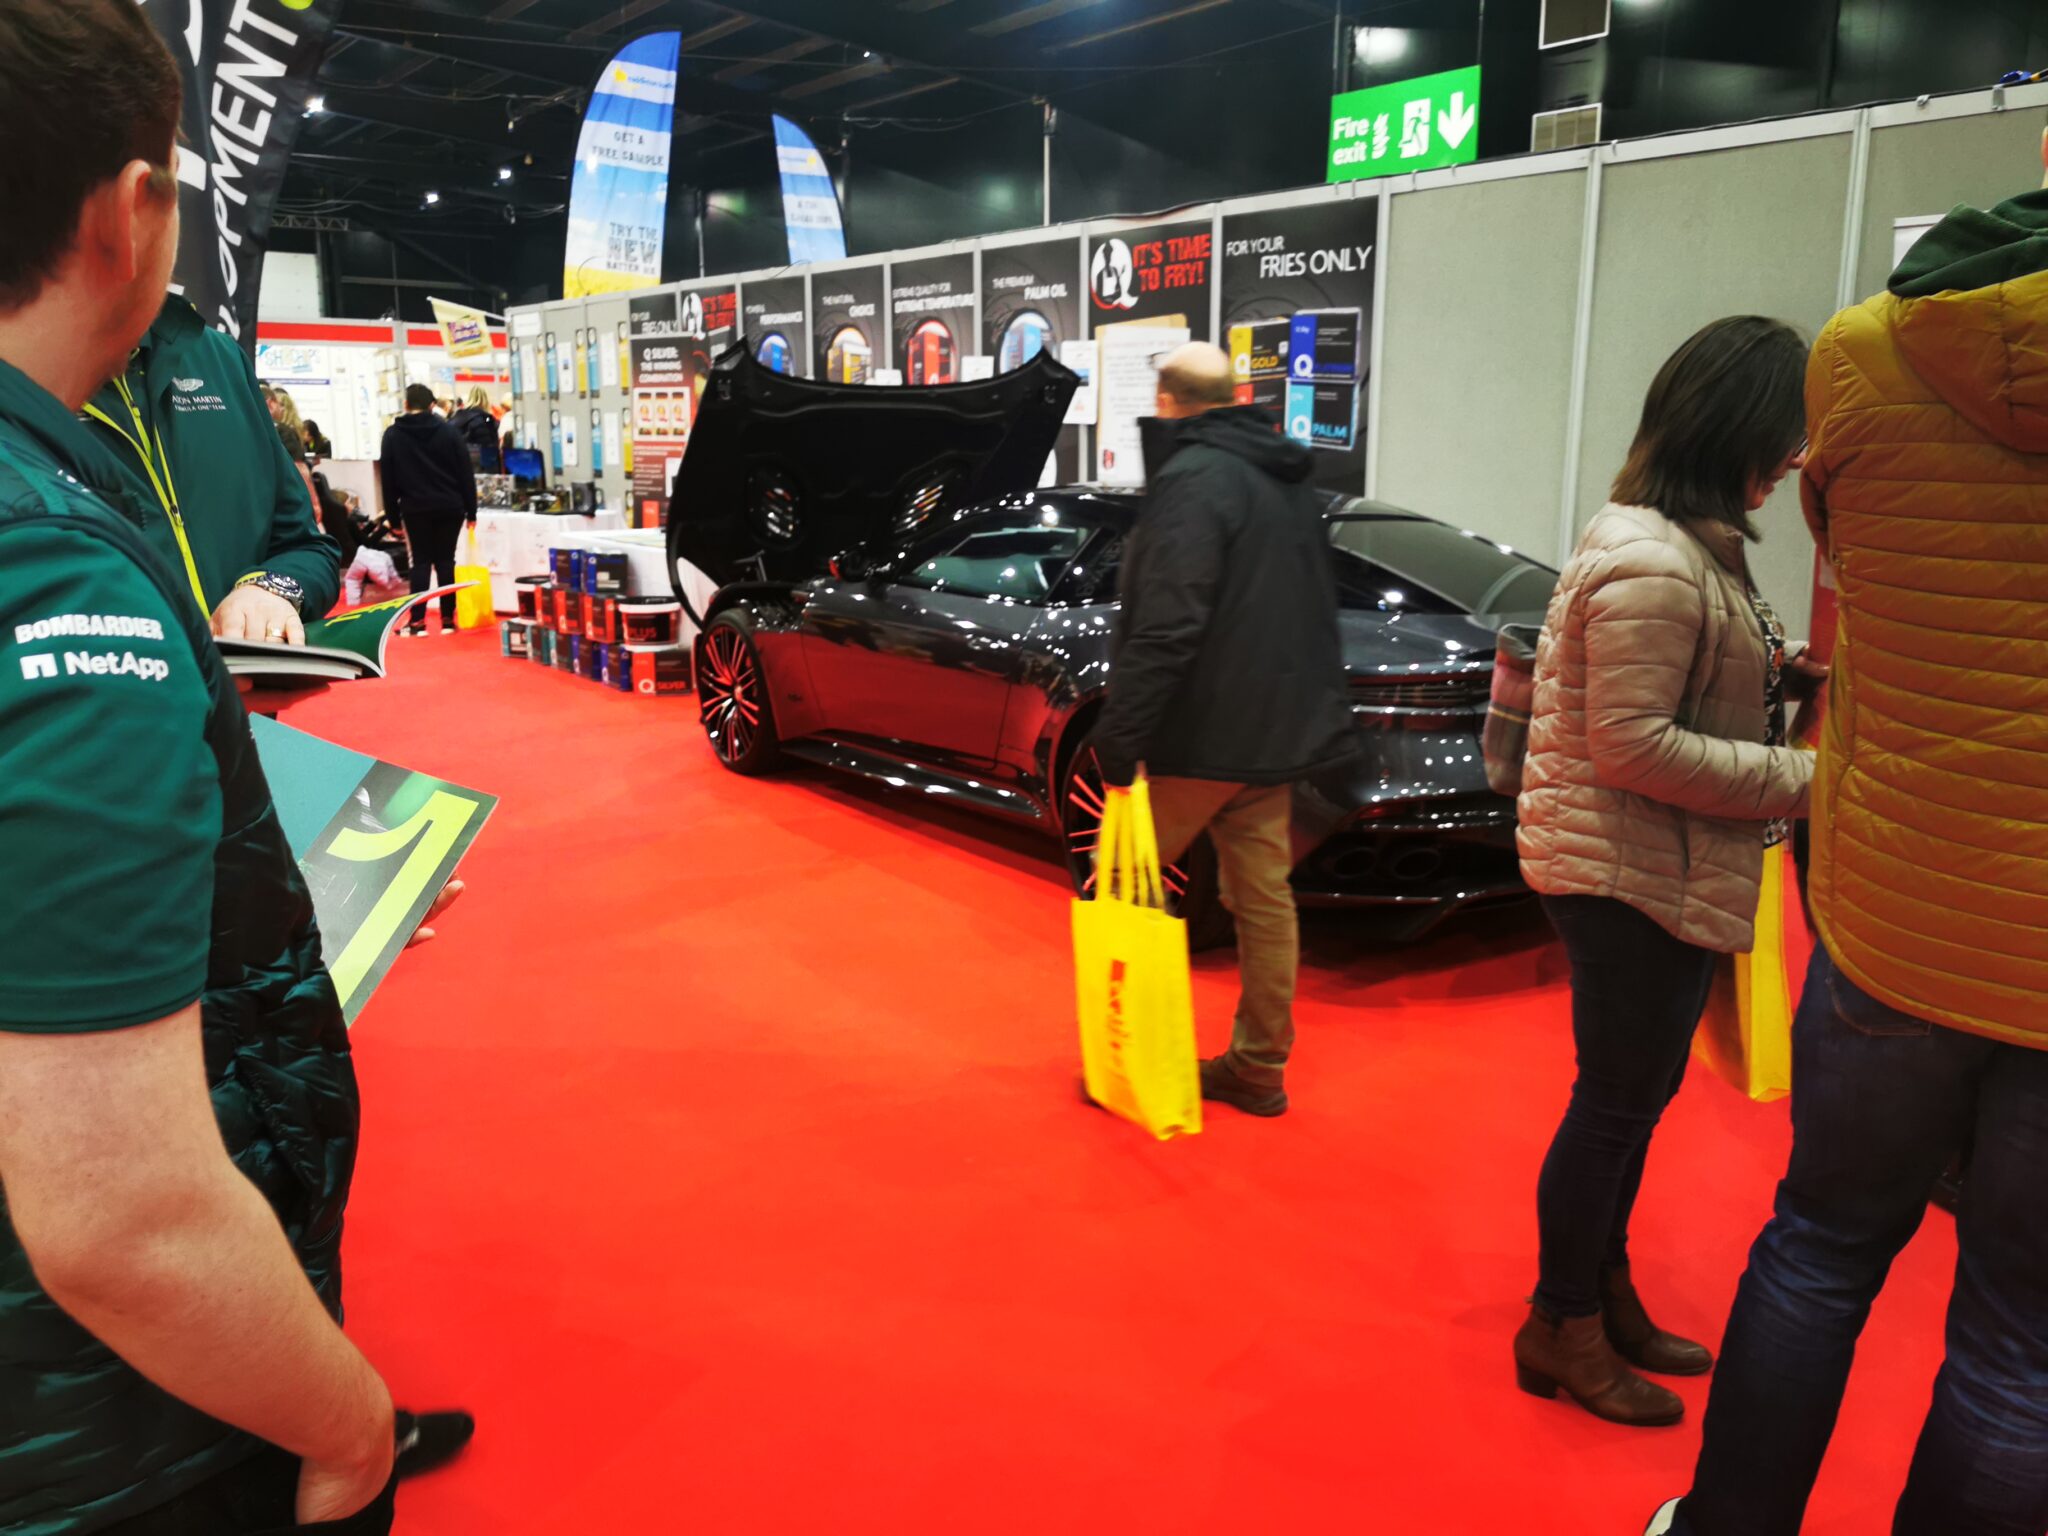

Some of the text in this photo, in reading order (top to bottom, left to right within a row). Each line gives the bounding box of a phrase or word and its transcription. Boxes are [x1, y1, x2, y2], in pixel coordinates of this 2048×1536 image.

[1333, 116, 1369, 140] Fire
[1332, 141, 1367, 165] exit
[609, 221, 634, 238] TRY
[1132, 233, 1211, 269] IT'S TIME
[1226, 235, 1285, 257] FOR YOUR
[1260, 245, 1373, 279] FRIES ONLY
[1138, 261, 1205, 292] TO FRY!
[1023, 282, 1068, 301] PALM OIL
[1235, 353, 1279, 375] Q GOLD
[1293, 353, 1314, 378] Q
[1291, 415, 1348, 440] Q PALM
[14, 614, 165, 645] BOMBARDIER
[63, 650, 170, 682] NetApp
[638, 678, 687, 695] Q SILVER
